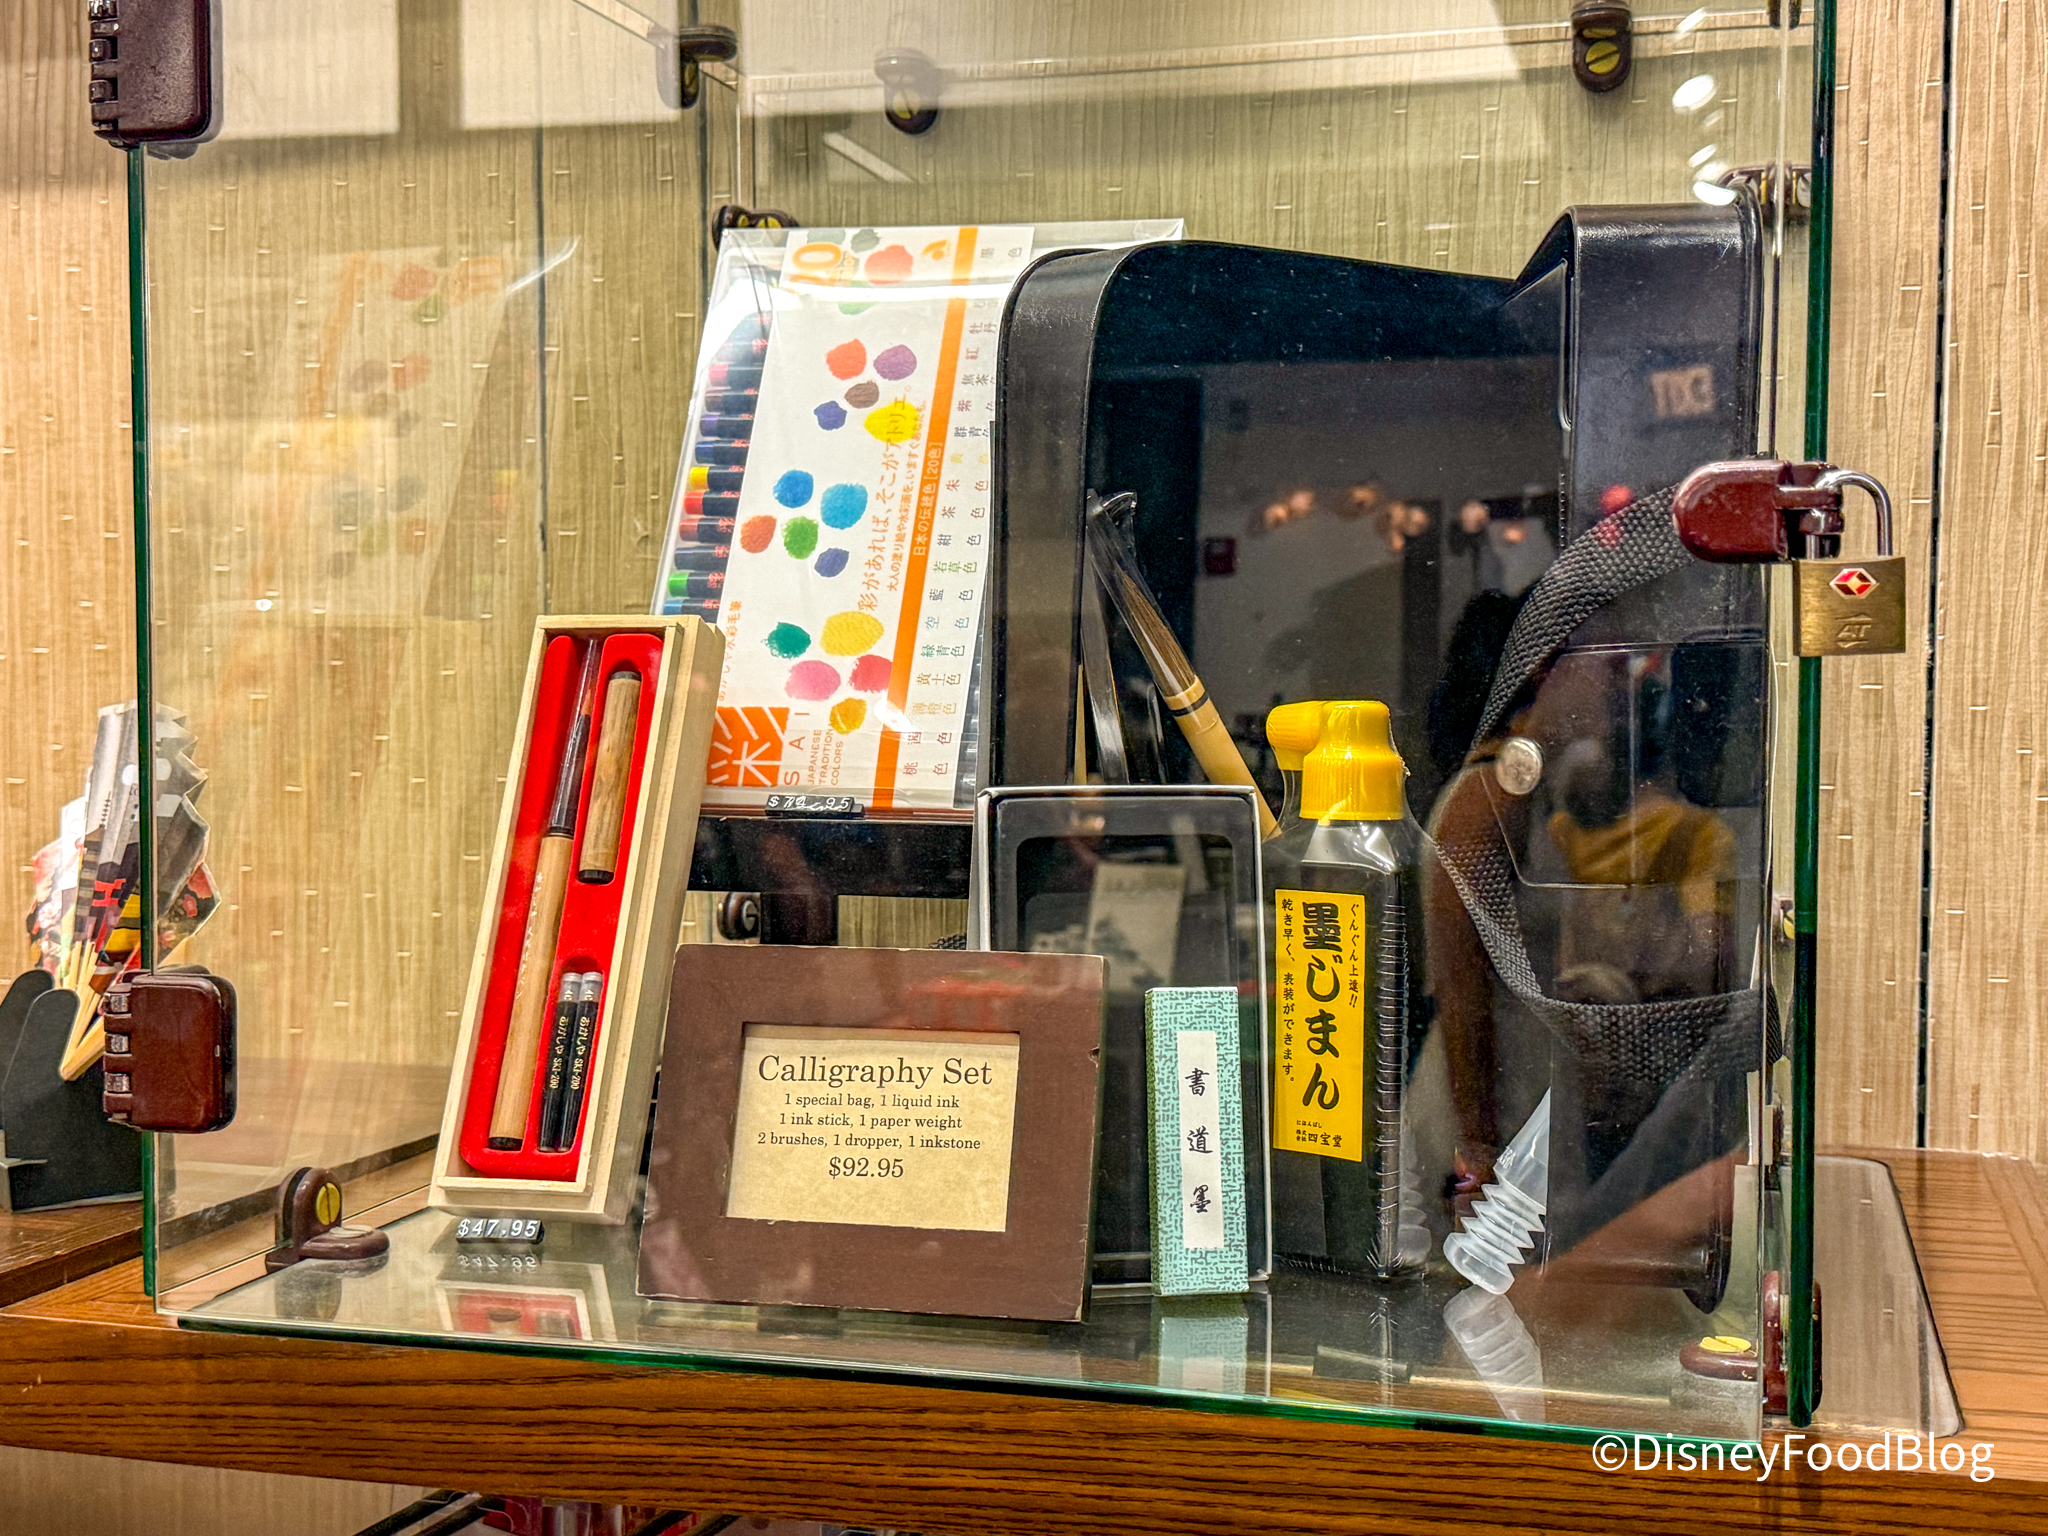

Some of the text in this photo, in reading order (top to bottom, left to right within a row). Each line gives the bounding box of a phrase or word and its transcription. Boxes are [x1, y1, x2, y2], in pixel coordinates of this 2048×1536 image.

[808, 730, 822, 786] JAPANESE
[819, 720, 836, 785] TRADITION
[831, 741, 844, 786] COLORS
[1302, 901, 1343, 1110] 墨じまん
[550, 1057, 563, 1089] SKI-200
[571, 1057, 584, 1090] SKI-200
[758, 1054, 992, 1089] Calligraphy Set
[784, 1093, 960, 1109] 1 special bag, 1 liquid ink
[779, 1113, 963, 1132] 1 ink stick, 1 paper weight
[757, 1133, 981, 1150] 2 brushes, 1 dropper, 1 inkstone
[1184, 1067, 1213, 1215] 書道墨
[828, 1156, 904, 1180] $92.95
[457, 1218, 538, 1237] $47.95
